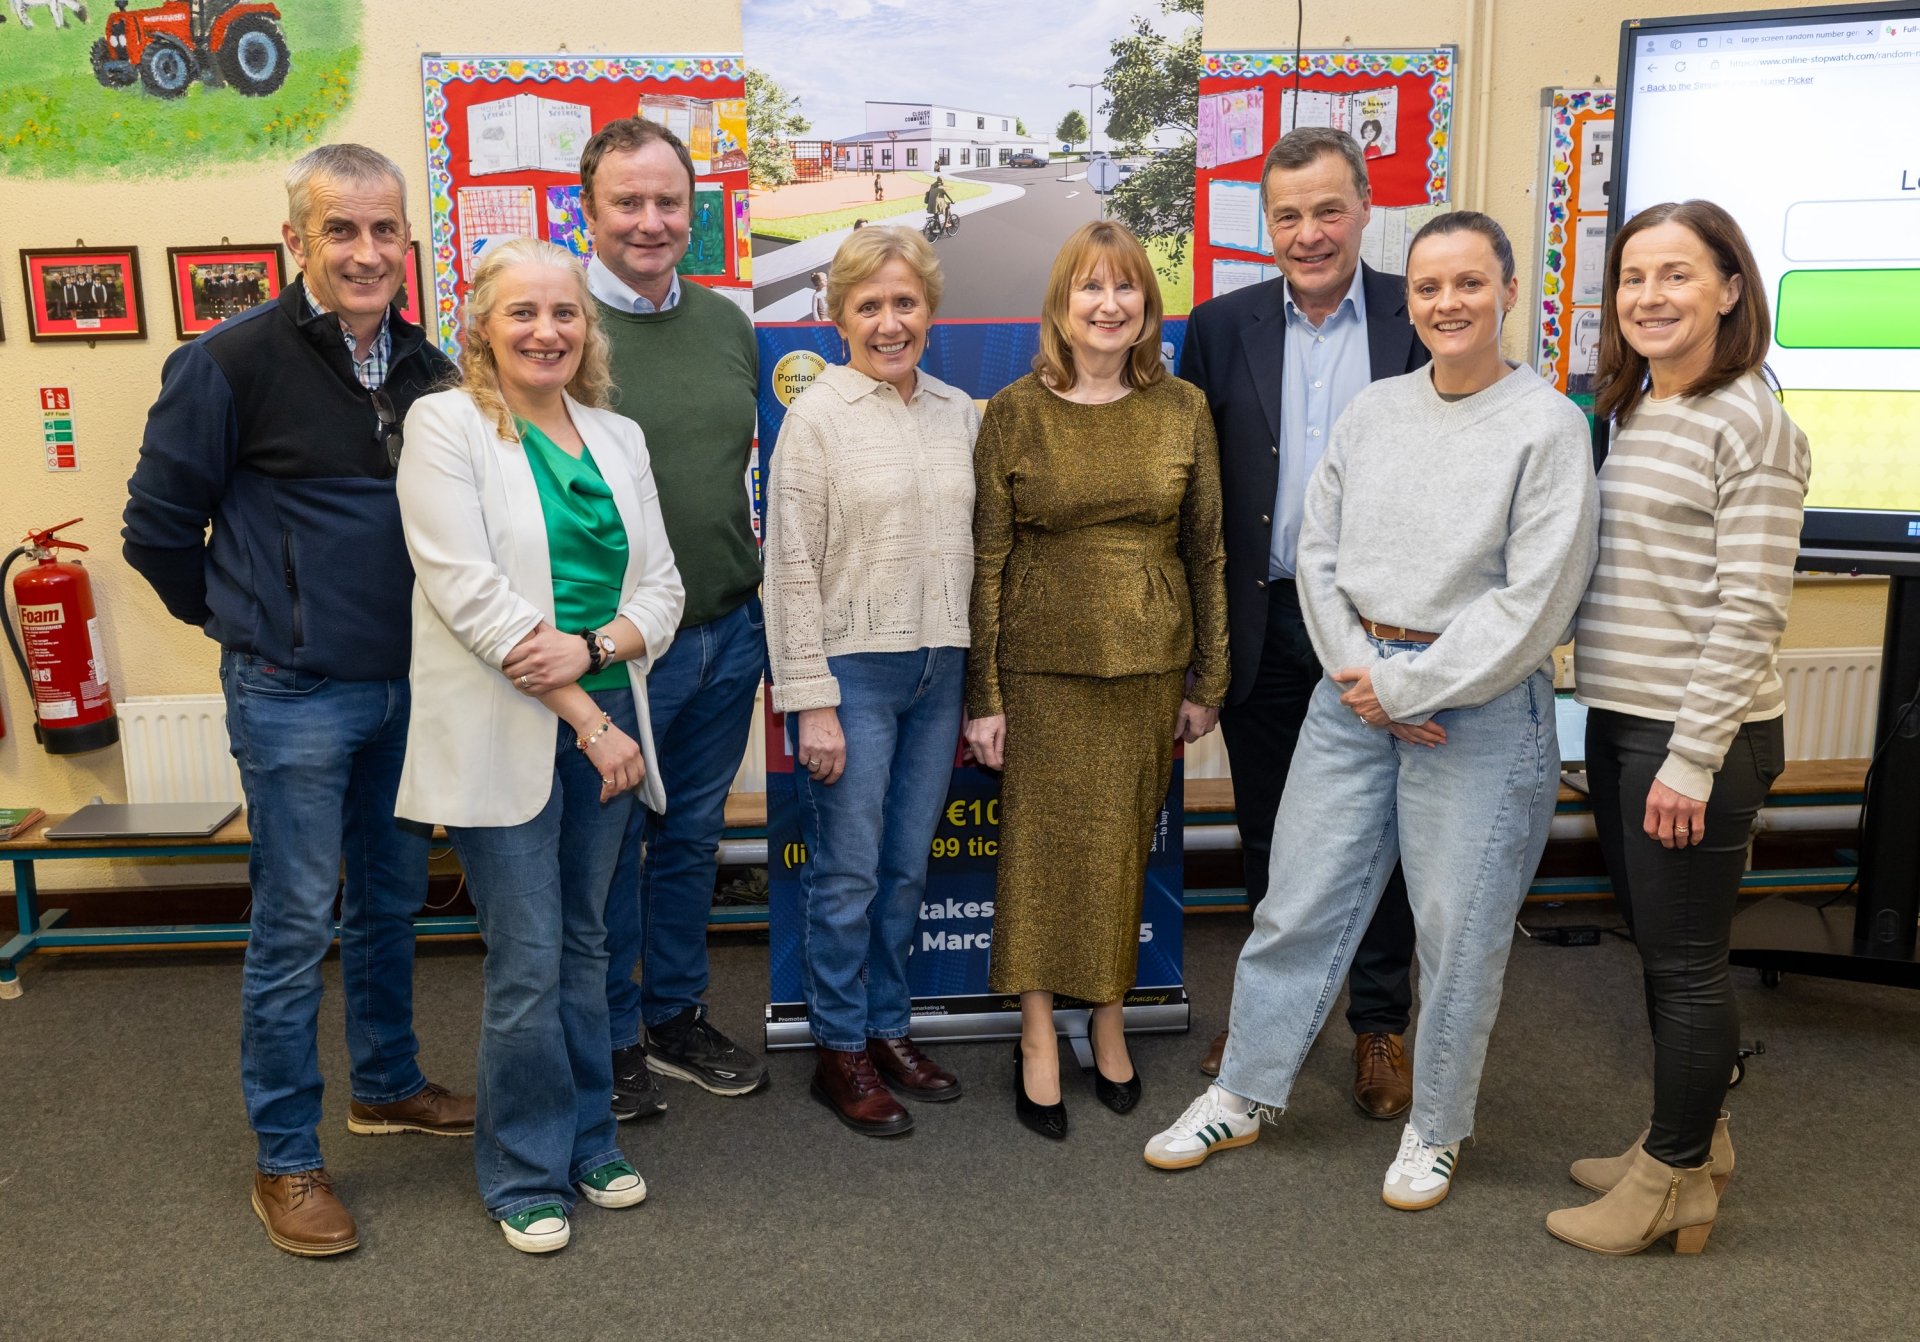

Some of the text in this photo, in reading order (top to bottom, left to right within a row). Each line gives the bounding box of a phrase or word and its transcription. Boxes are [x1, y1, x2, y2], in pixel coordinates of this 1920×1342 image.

[1741, 36, 1759, 44] large
[1786, 32, 1814, 40] random
[1816, 31, 1844, 39] number
[1903, 25, 1920, 33] Full-
[1647, 84, 1667, 92] Back
[1669, 83, 1677, 91] to
[1679, 82, 1692, 90] the
[1760, 77, 1785, 86] Name
[1787, 75, 1815, 85] Picker
[1354, 99, 1391, 109] The hunger
[1902, 169, 1920, 190] L
[778, 354, 800, 372] Licence
[777, 373, 816, 382] Portlaoi
[21, 608, 60, 623] Foam
[1159, 810, 1170, 836] to buy
[783, 843, 806, 869] (li
[967, 836, 998, 857] tic
[919, 898, 995, 920] takes
[922, 928, 994, 952] Marc
[1138, 922, 1154, 943] 5
[1001, 999, 1022, 1009] Put
[1125, 994, 1170, 1005] draising!
